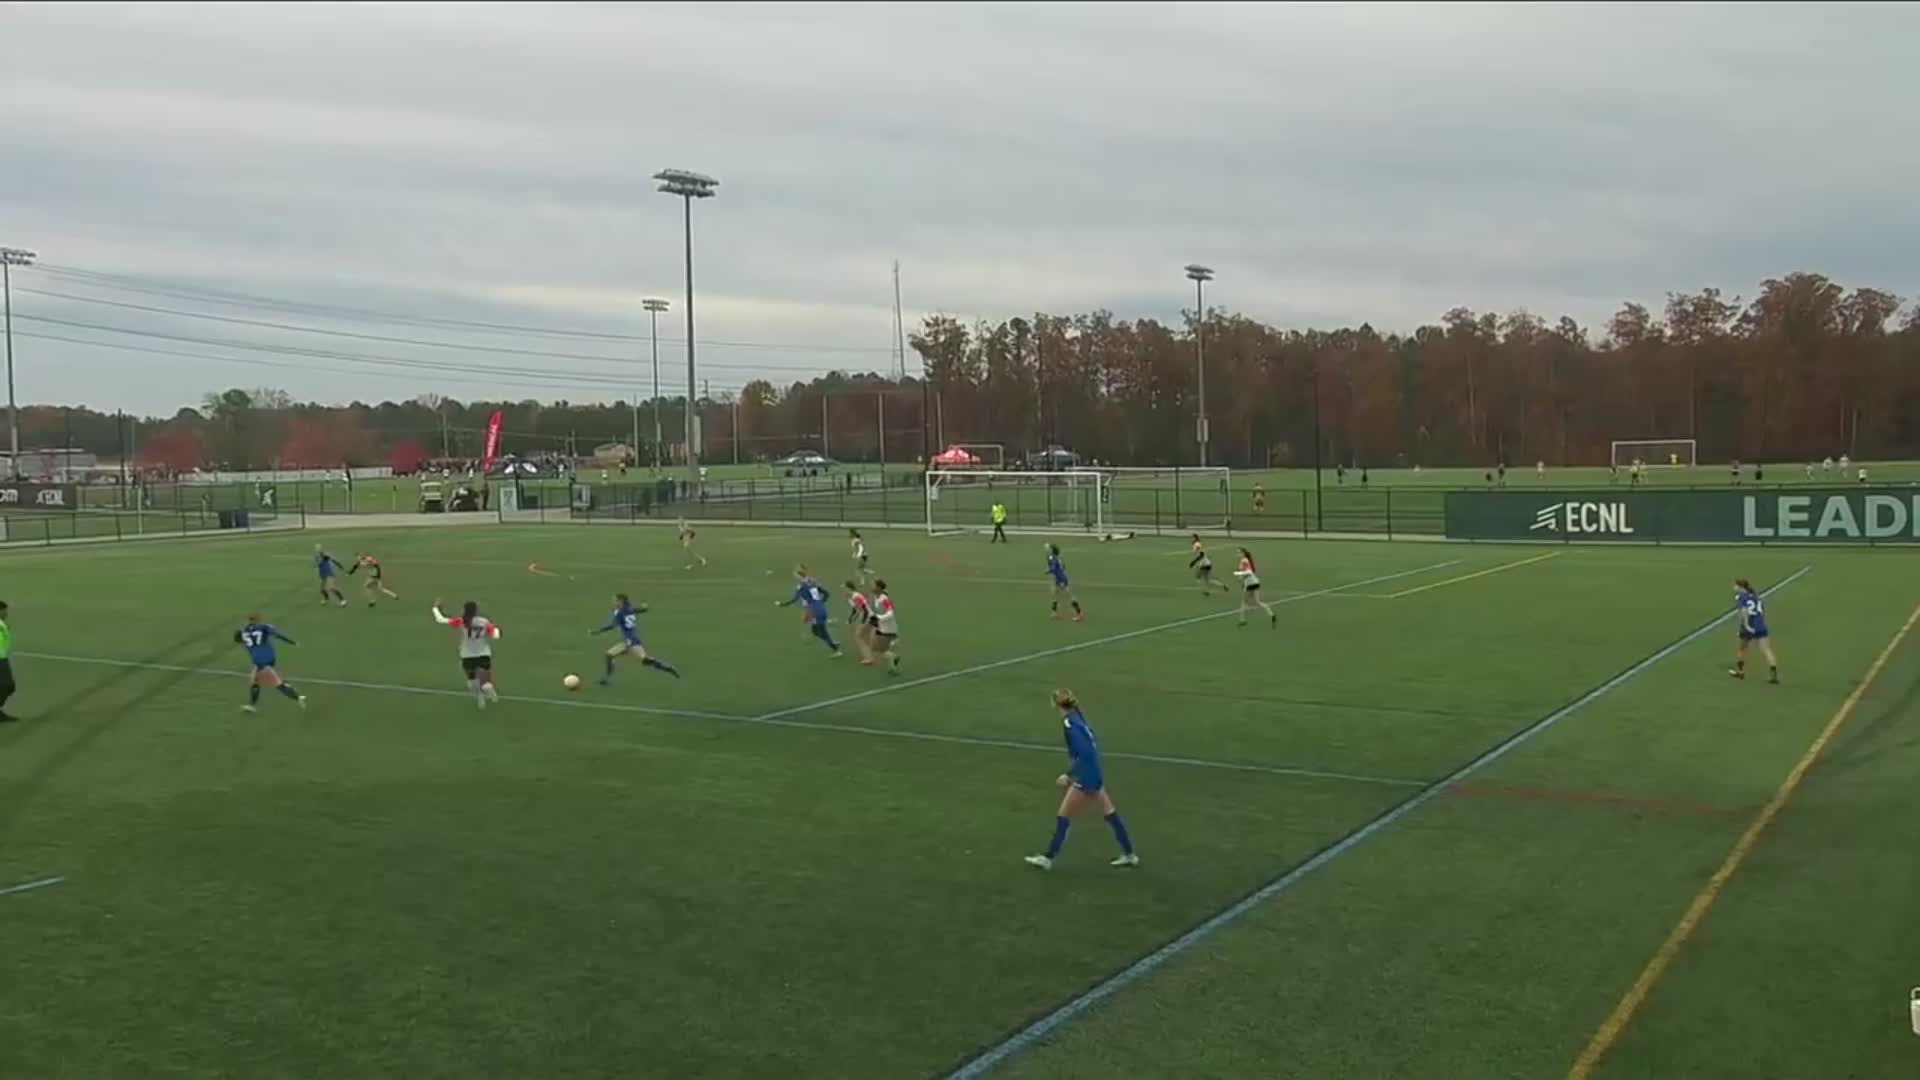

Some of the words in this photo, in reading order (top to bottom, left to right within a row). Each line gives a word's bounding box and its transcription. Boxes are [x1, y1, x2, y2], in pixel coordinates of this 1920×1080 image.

[1566, 502, 1634, 532] ECNL
[1744, 495, 1920, 537] LEAD
[242, 631, 263, 647] 57
